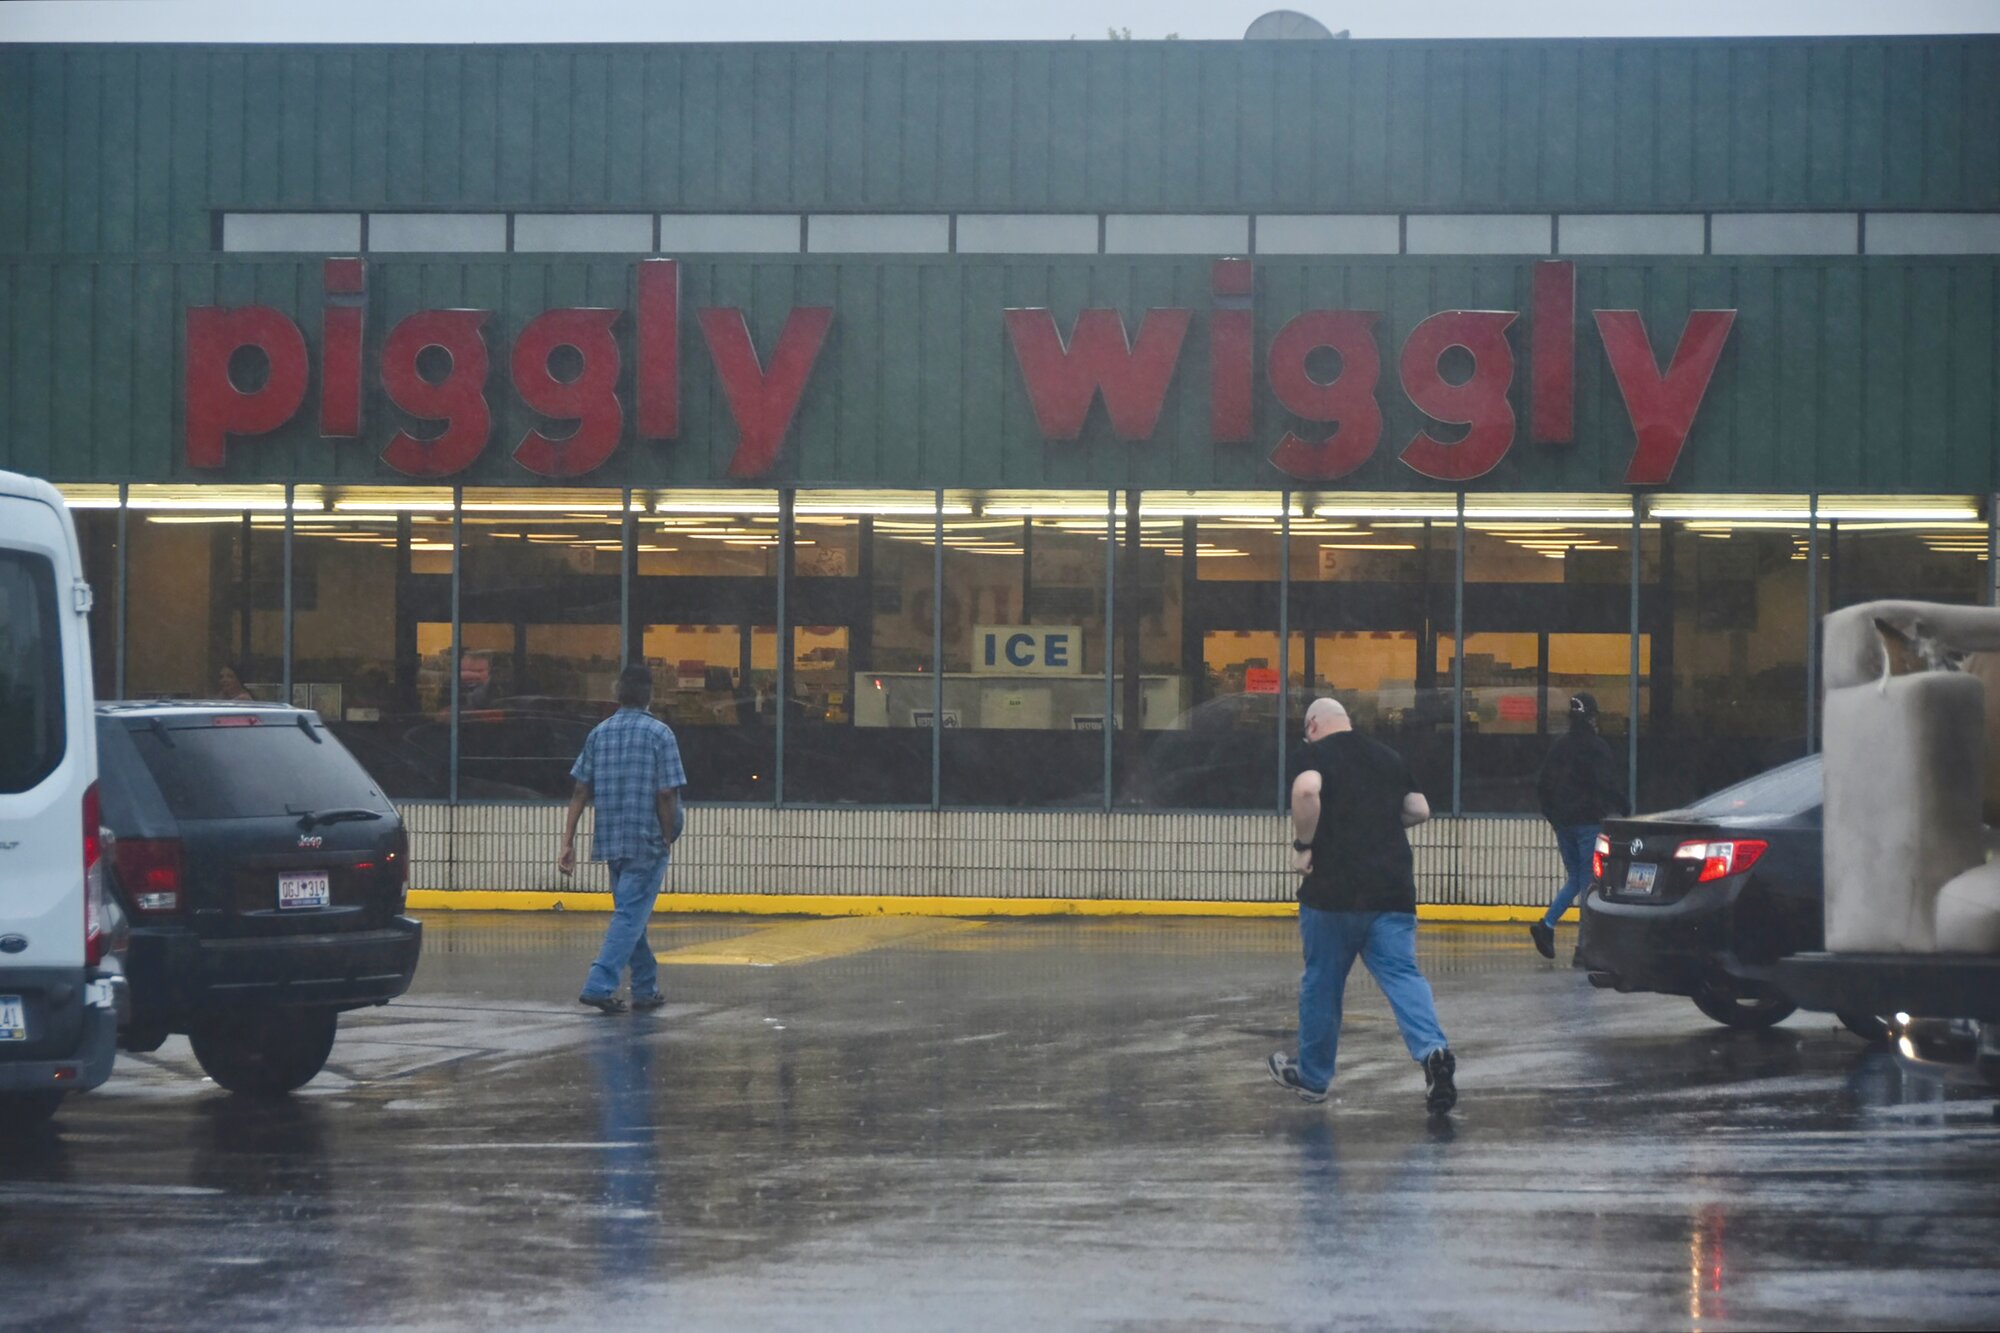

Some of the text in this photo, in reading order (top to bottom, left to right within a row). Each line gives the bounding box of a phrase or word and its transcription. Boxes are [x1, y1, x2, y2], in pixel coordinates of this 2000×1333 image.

[186, 257, 1738, 485] piggly wiggly
[1324, 552, 1337, 569] 5
[984, 633, 1069, 667] ICE
[308, 879, 326, 897] 319
